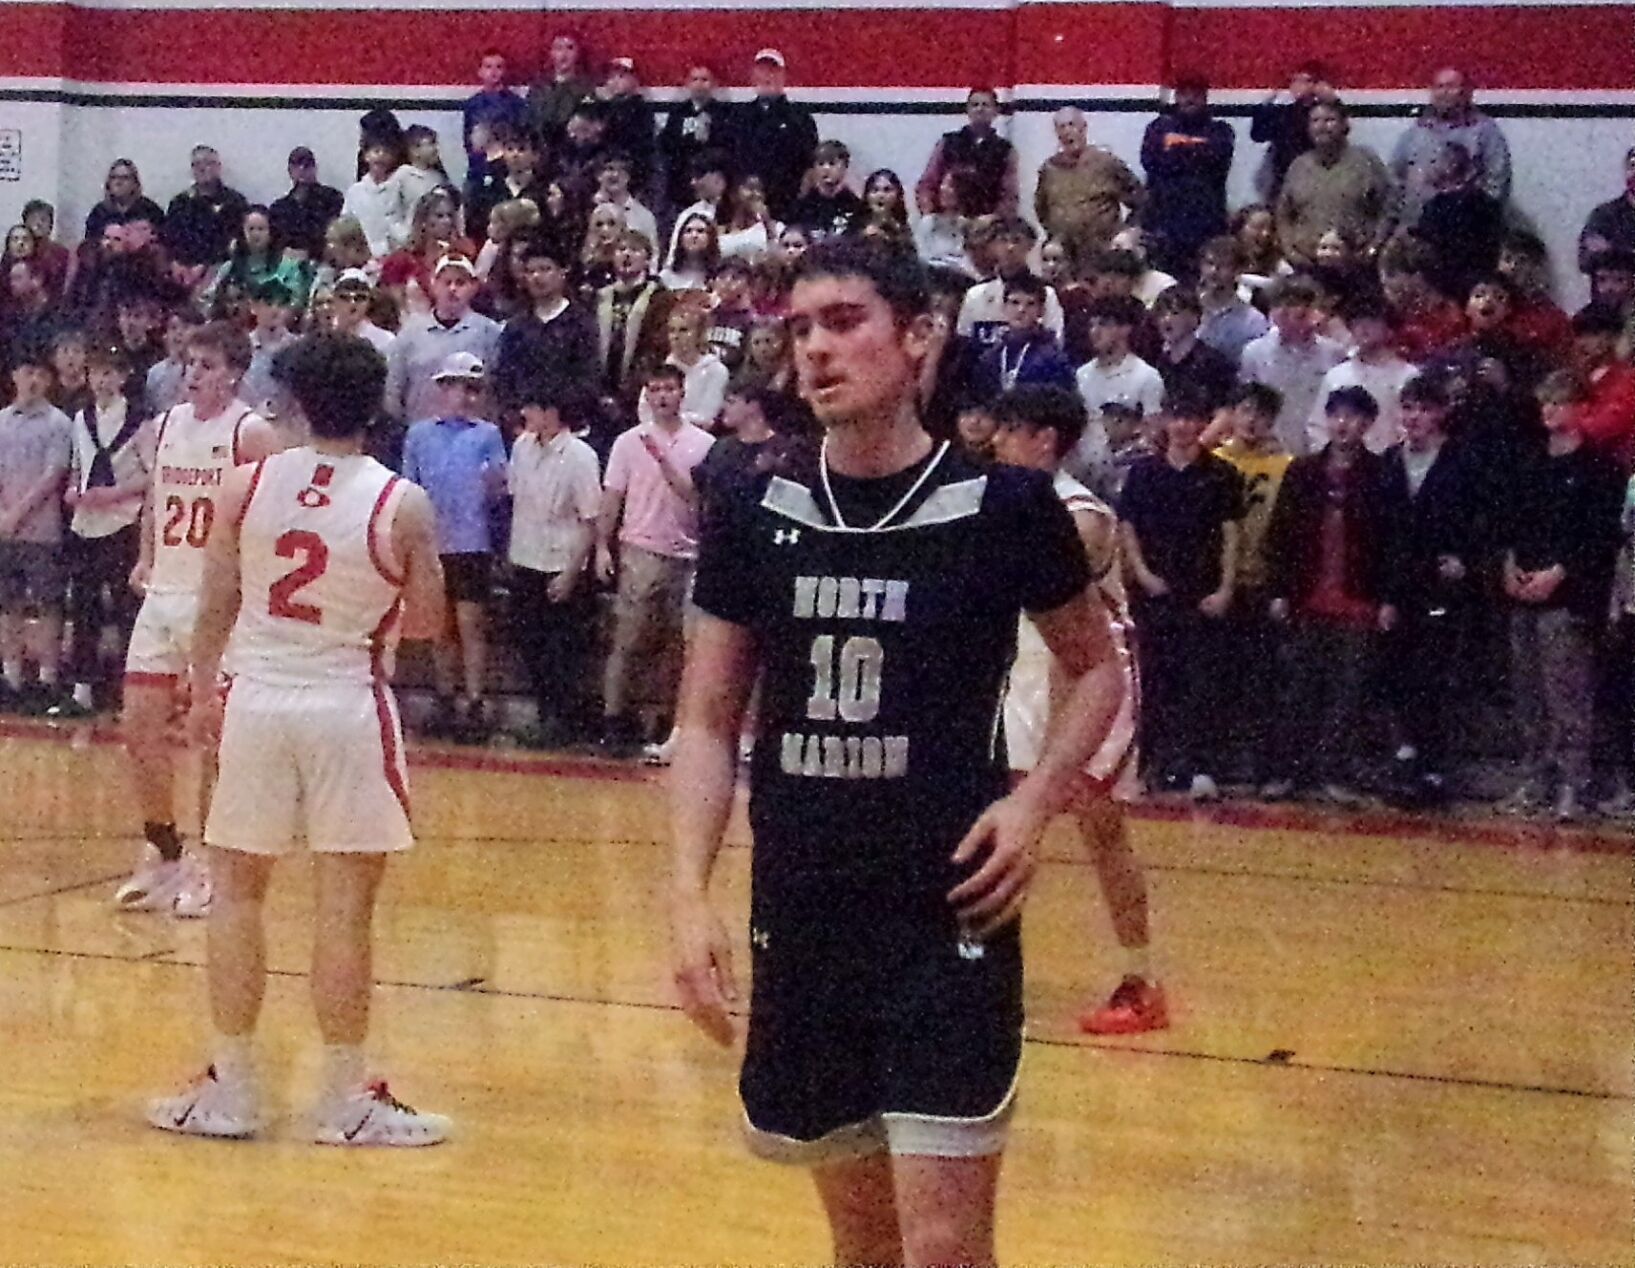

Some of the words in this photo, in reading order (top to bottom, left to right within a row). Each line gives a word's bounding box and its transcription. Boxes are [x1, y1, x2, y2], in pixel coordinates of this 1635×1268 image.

[163, 495, 214, 548] 20
[268, 529, 329, 625] 2
[793, 576, 909, 621] NORTH
[807, 635, 884, 722] 10
[780, 733, 909, 778] MARION
